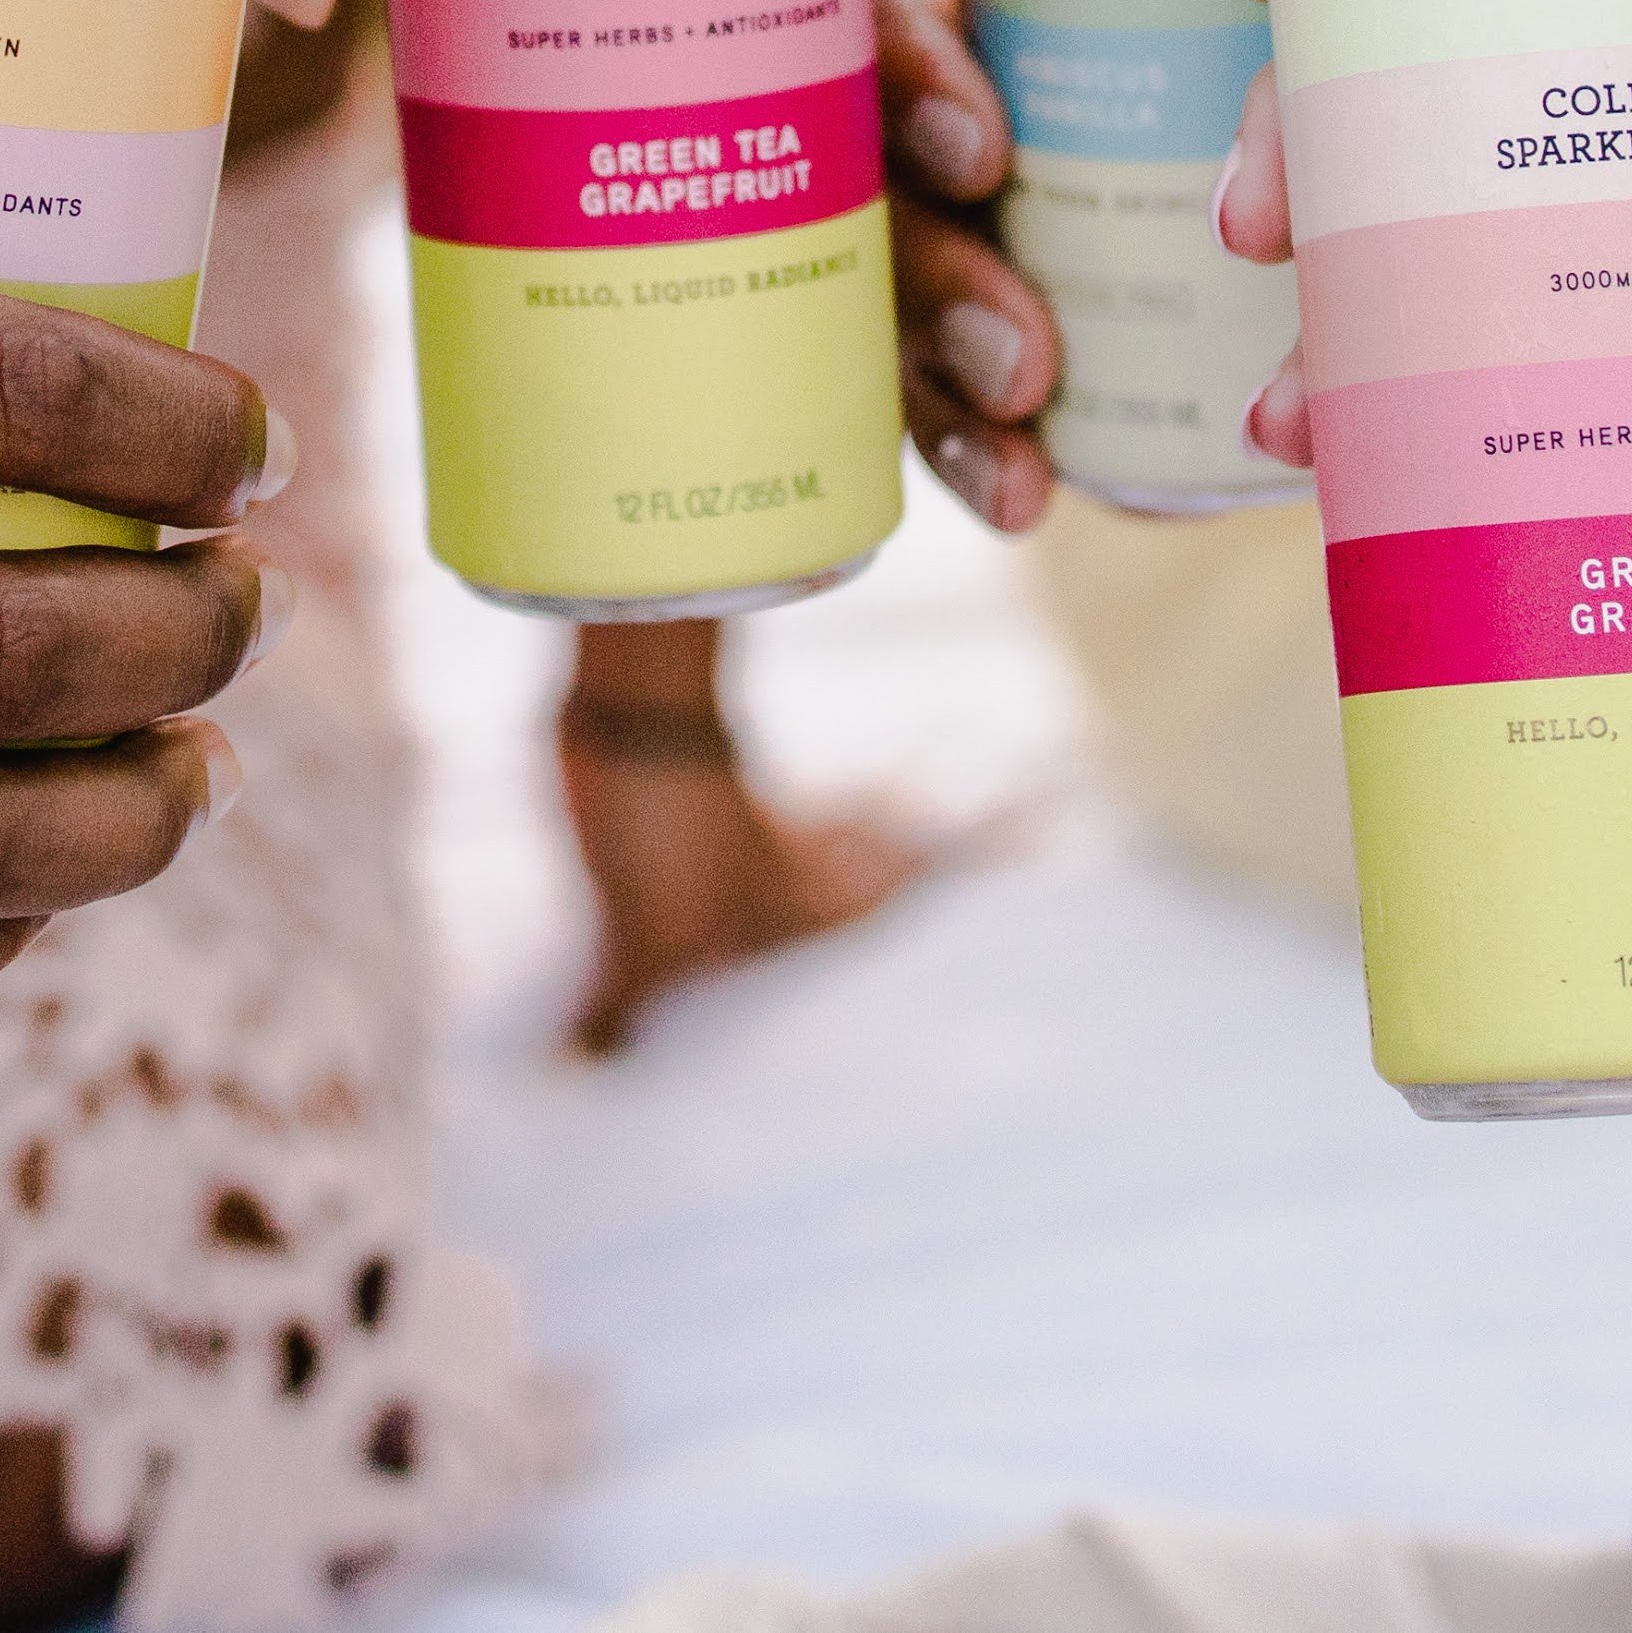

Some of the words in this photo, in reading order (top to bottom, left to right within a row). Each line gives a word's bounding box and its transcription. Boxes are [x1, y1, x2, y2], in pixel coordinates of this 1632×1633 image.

[508, 29, 582, 49] SUPER
[594, 25, 674, 47] HERBS
[589, 136, 722, 178] GREEN
[733, 124, 802, 164] TEA
[579, 159, 812, 218] GRAPEFRUIT
[632, 273, 736, 305] LIQUID
[1484, 431, 1565, 455] SUPER
[615, 492, 641, 524] 12
[1506, 716, 1618, 743] HELLO,
